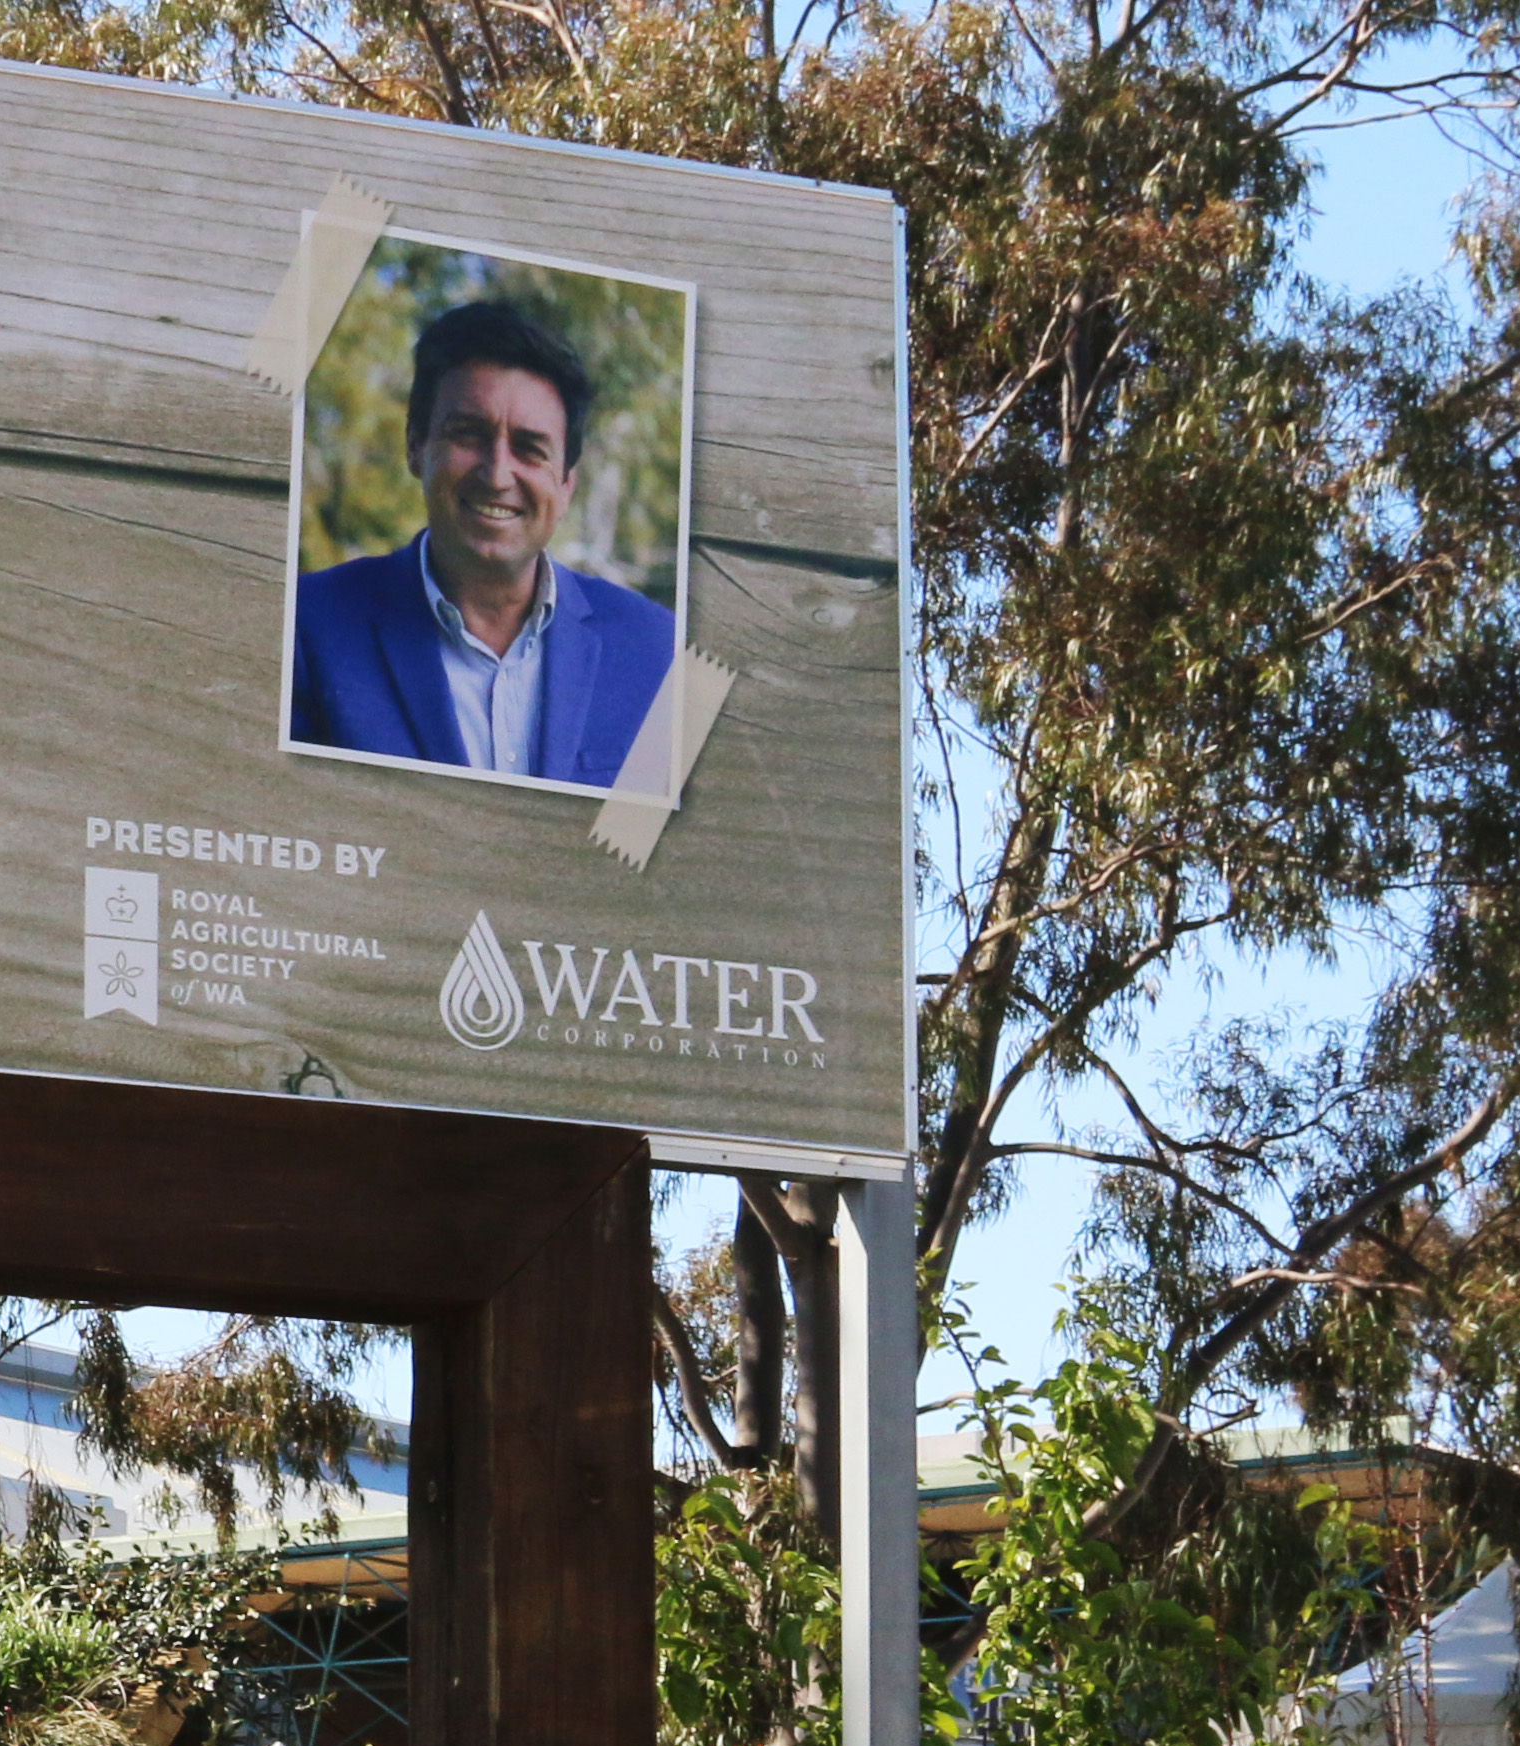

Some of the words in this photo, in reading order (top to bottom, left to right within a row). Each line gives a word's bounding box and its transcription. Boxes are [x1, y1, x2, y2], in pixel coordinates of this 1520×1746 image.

[86, 816, 322, 871] PRESENTED
[334, 843, 386, 878] BY
[170, 888, 263, 918] ROYAL
[170, 919, 387, 960] AGRICULTURAL
[170, 948, 295, 980] SOCIETY
[170, 979, 200, 1006] of
[203, 982, 247, 1005] WA
[522, 940, 825, 1044] WATER
[536, 1024, 826, 1070] CORPORATION
